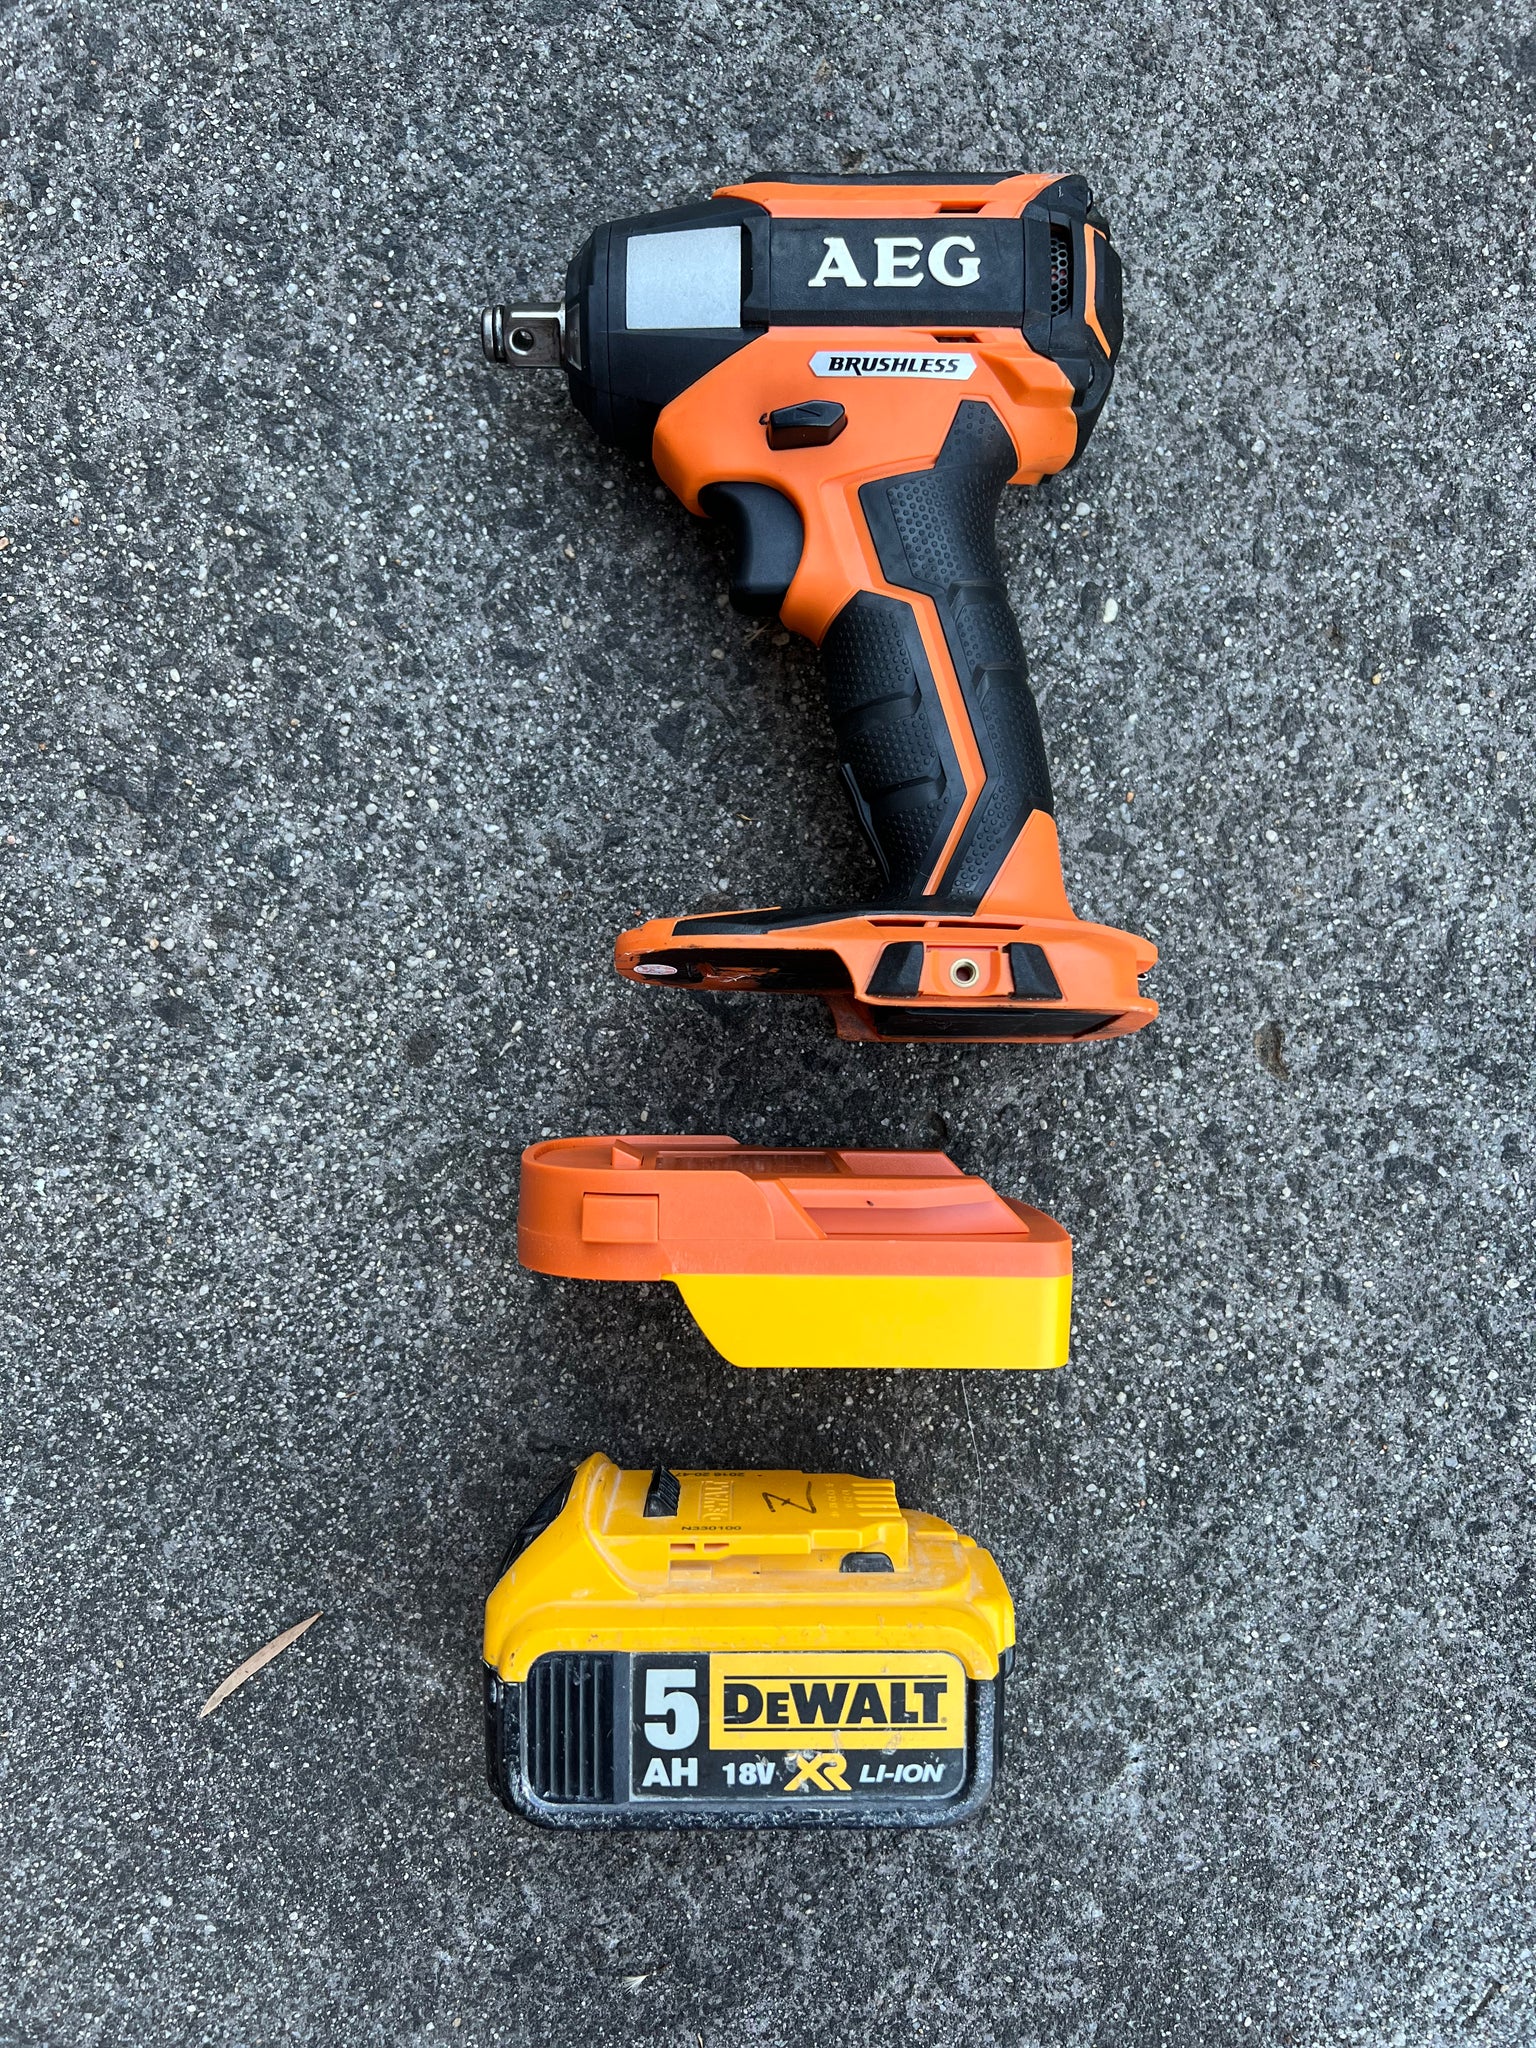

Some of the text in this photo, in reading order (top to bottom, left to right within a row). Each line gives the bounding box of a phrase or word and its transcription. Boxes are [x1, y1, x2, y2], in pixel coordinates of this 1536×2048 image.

[807, 235, 981, 287] AEG
[828, 356, 960, 376] BRUSHLESS
[644, 1668, 700, 1749] 5
[641, 1757, 699, 1787] AH
[722, 1752, 946, 1791] 18V XR LI-ION
